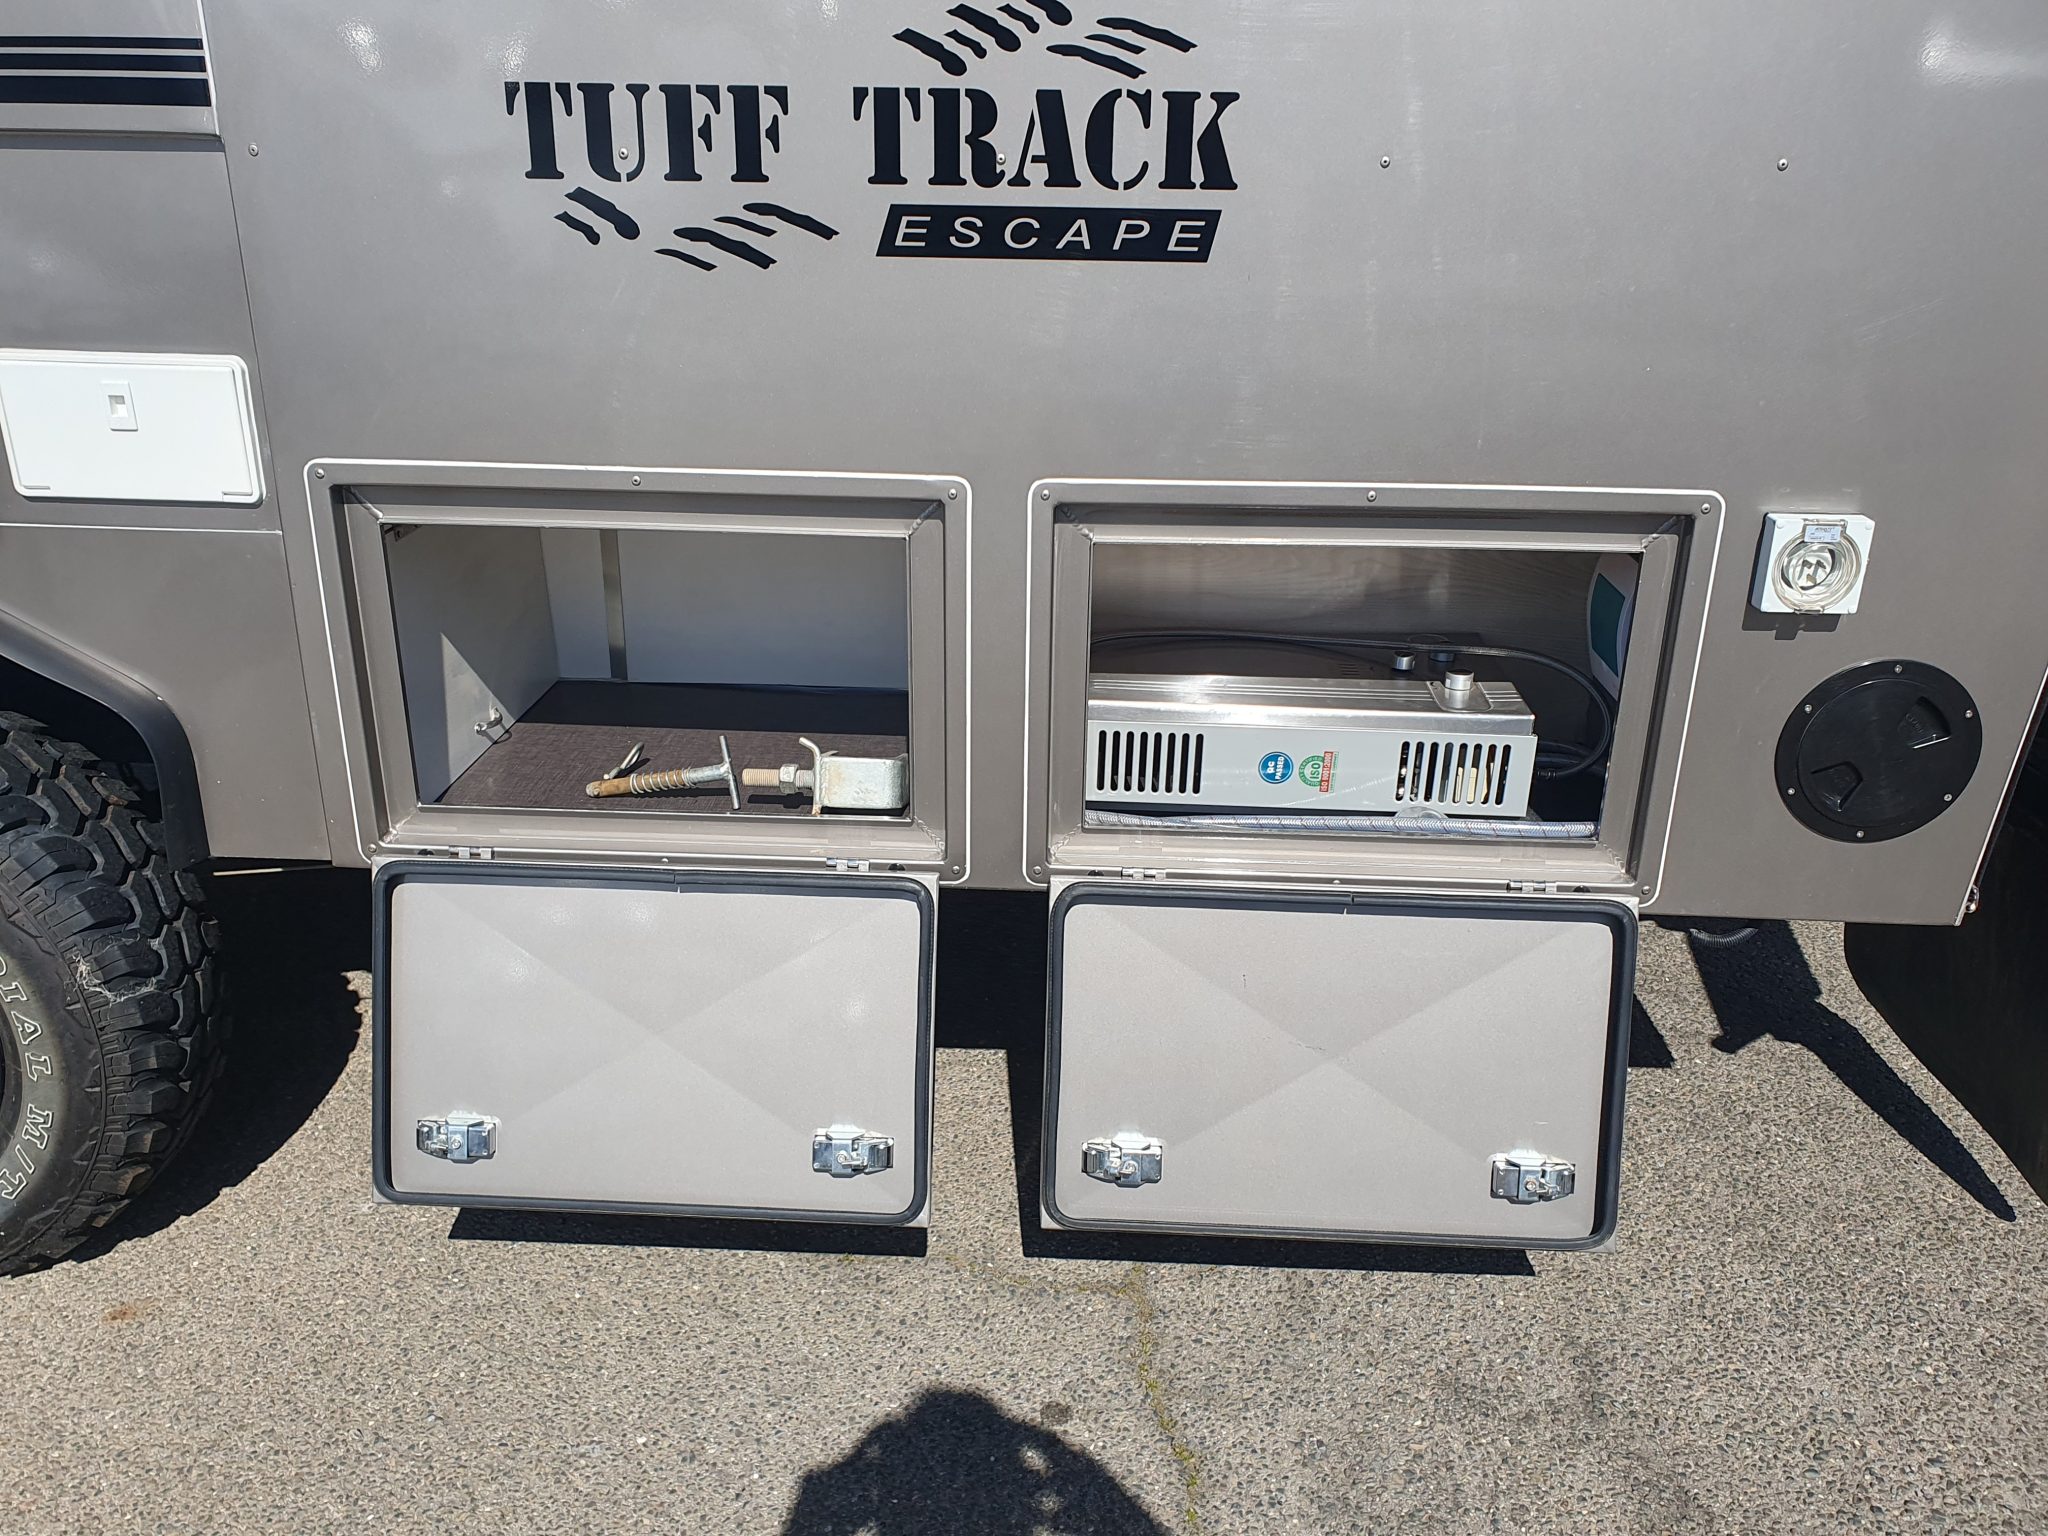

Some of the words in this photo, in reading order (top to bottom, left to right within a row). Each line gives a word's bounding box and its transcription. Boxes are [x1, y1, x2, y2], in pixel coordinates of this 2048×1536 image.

[504, 82, 789, 183] TUFF
[853, 86, 1241, 191] TRACK
[894, 214, 1207, 253] ESCAPE
[1275, 756, 1285, 780] PASSED
[1310, 762, 1321, 779] ISO
[1320, 781, 1328, 792] ISO
